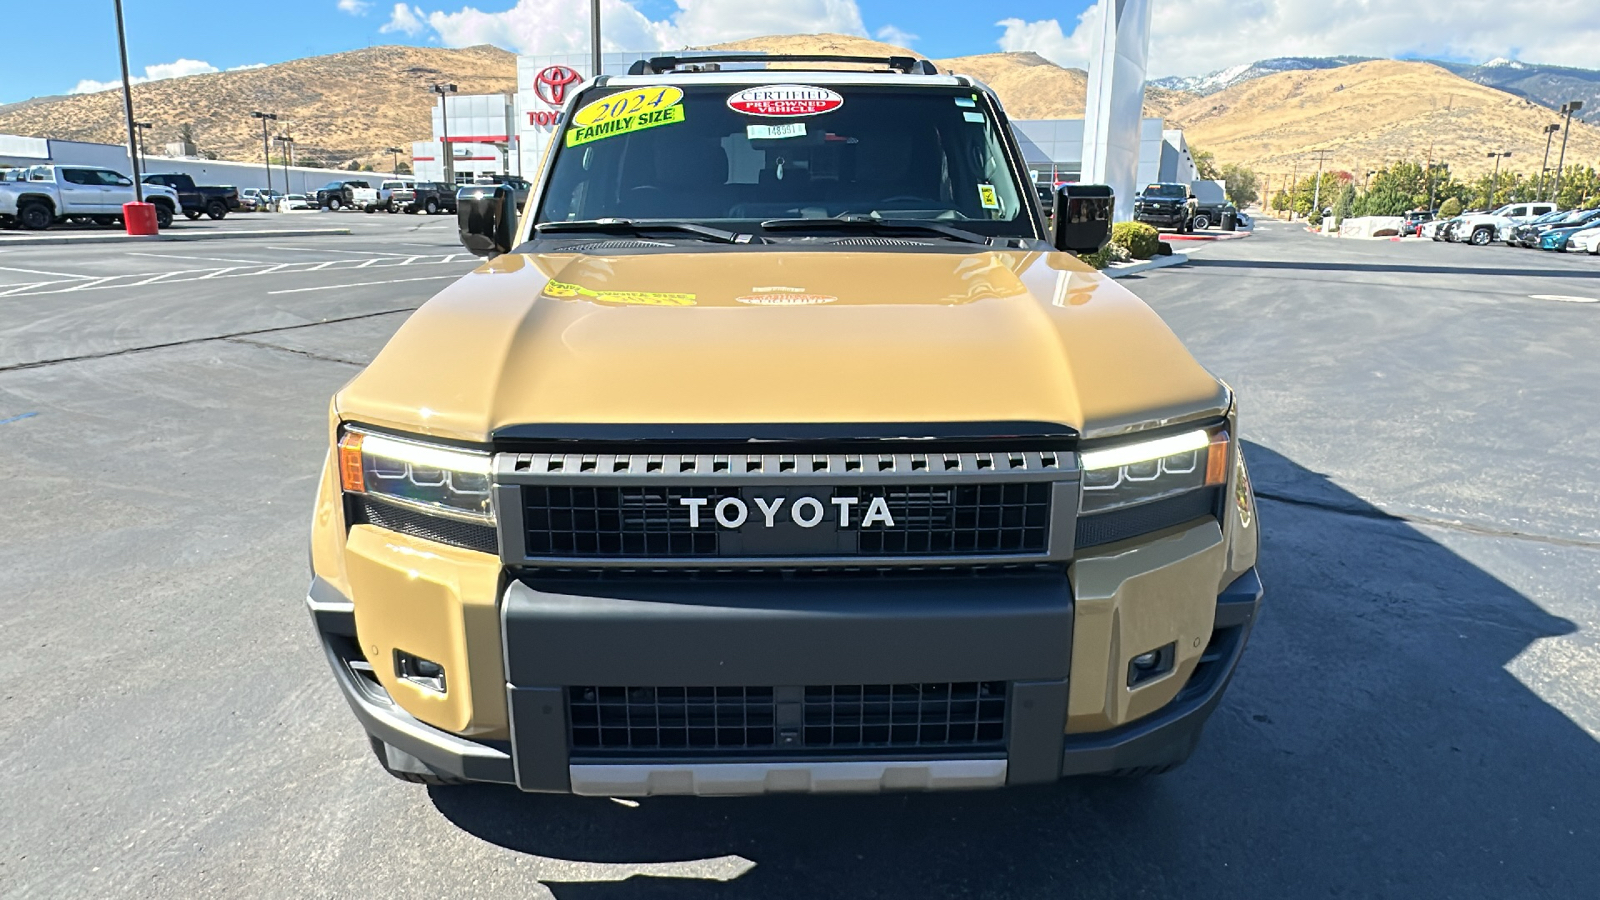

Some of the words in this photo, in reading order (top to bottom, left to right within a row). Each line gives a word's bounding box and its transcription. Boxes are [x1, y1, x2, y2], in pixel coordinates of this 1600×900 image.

[592, 88, 668, 123] 2024
[741, 91, 829, 101] CERTIFIED
[526, 110, 559, 126] TOY
[575, 116, 634, 141] FAMILY
[638, 108, 673, 126] SIZE
[680, 496, 895, 529] TOYOTA
